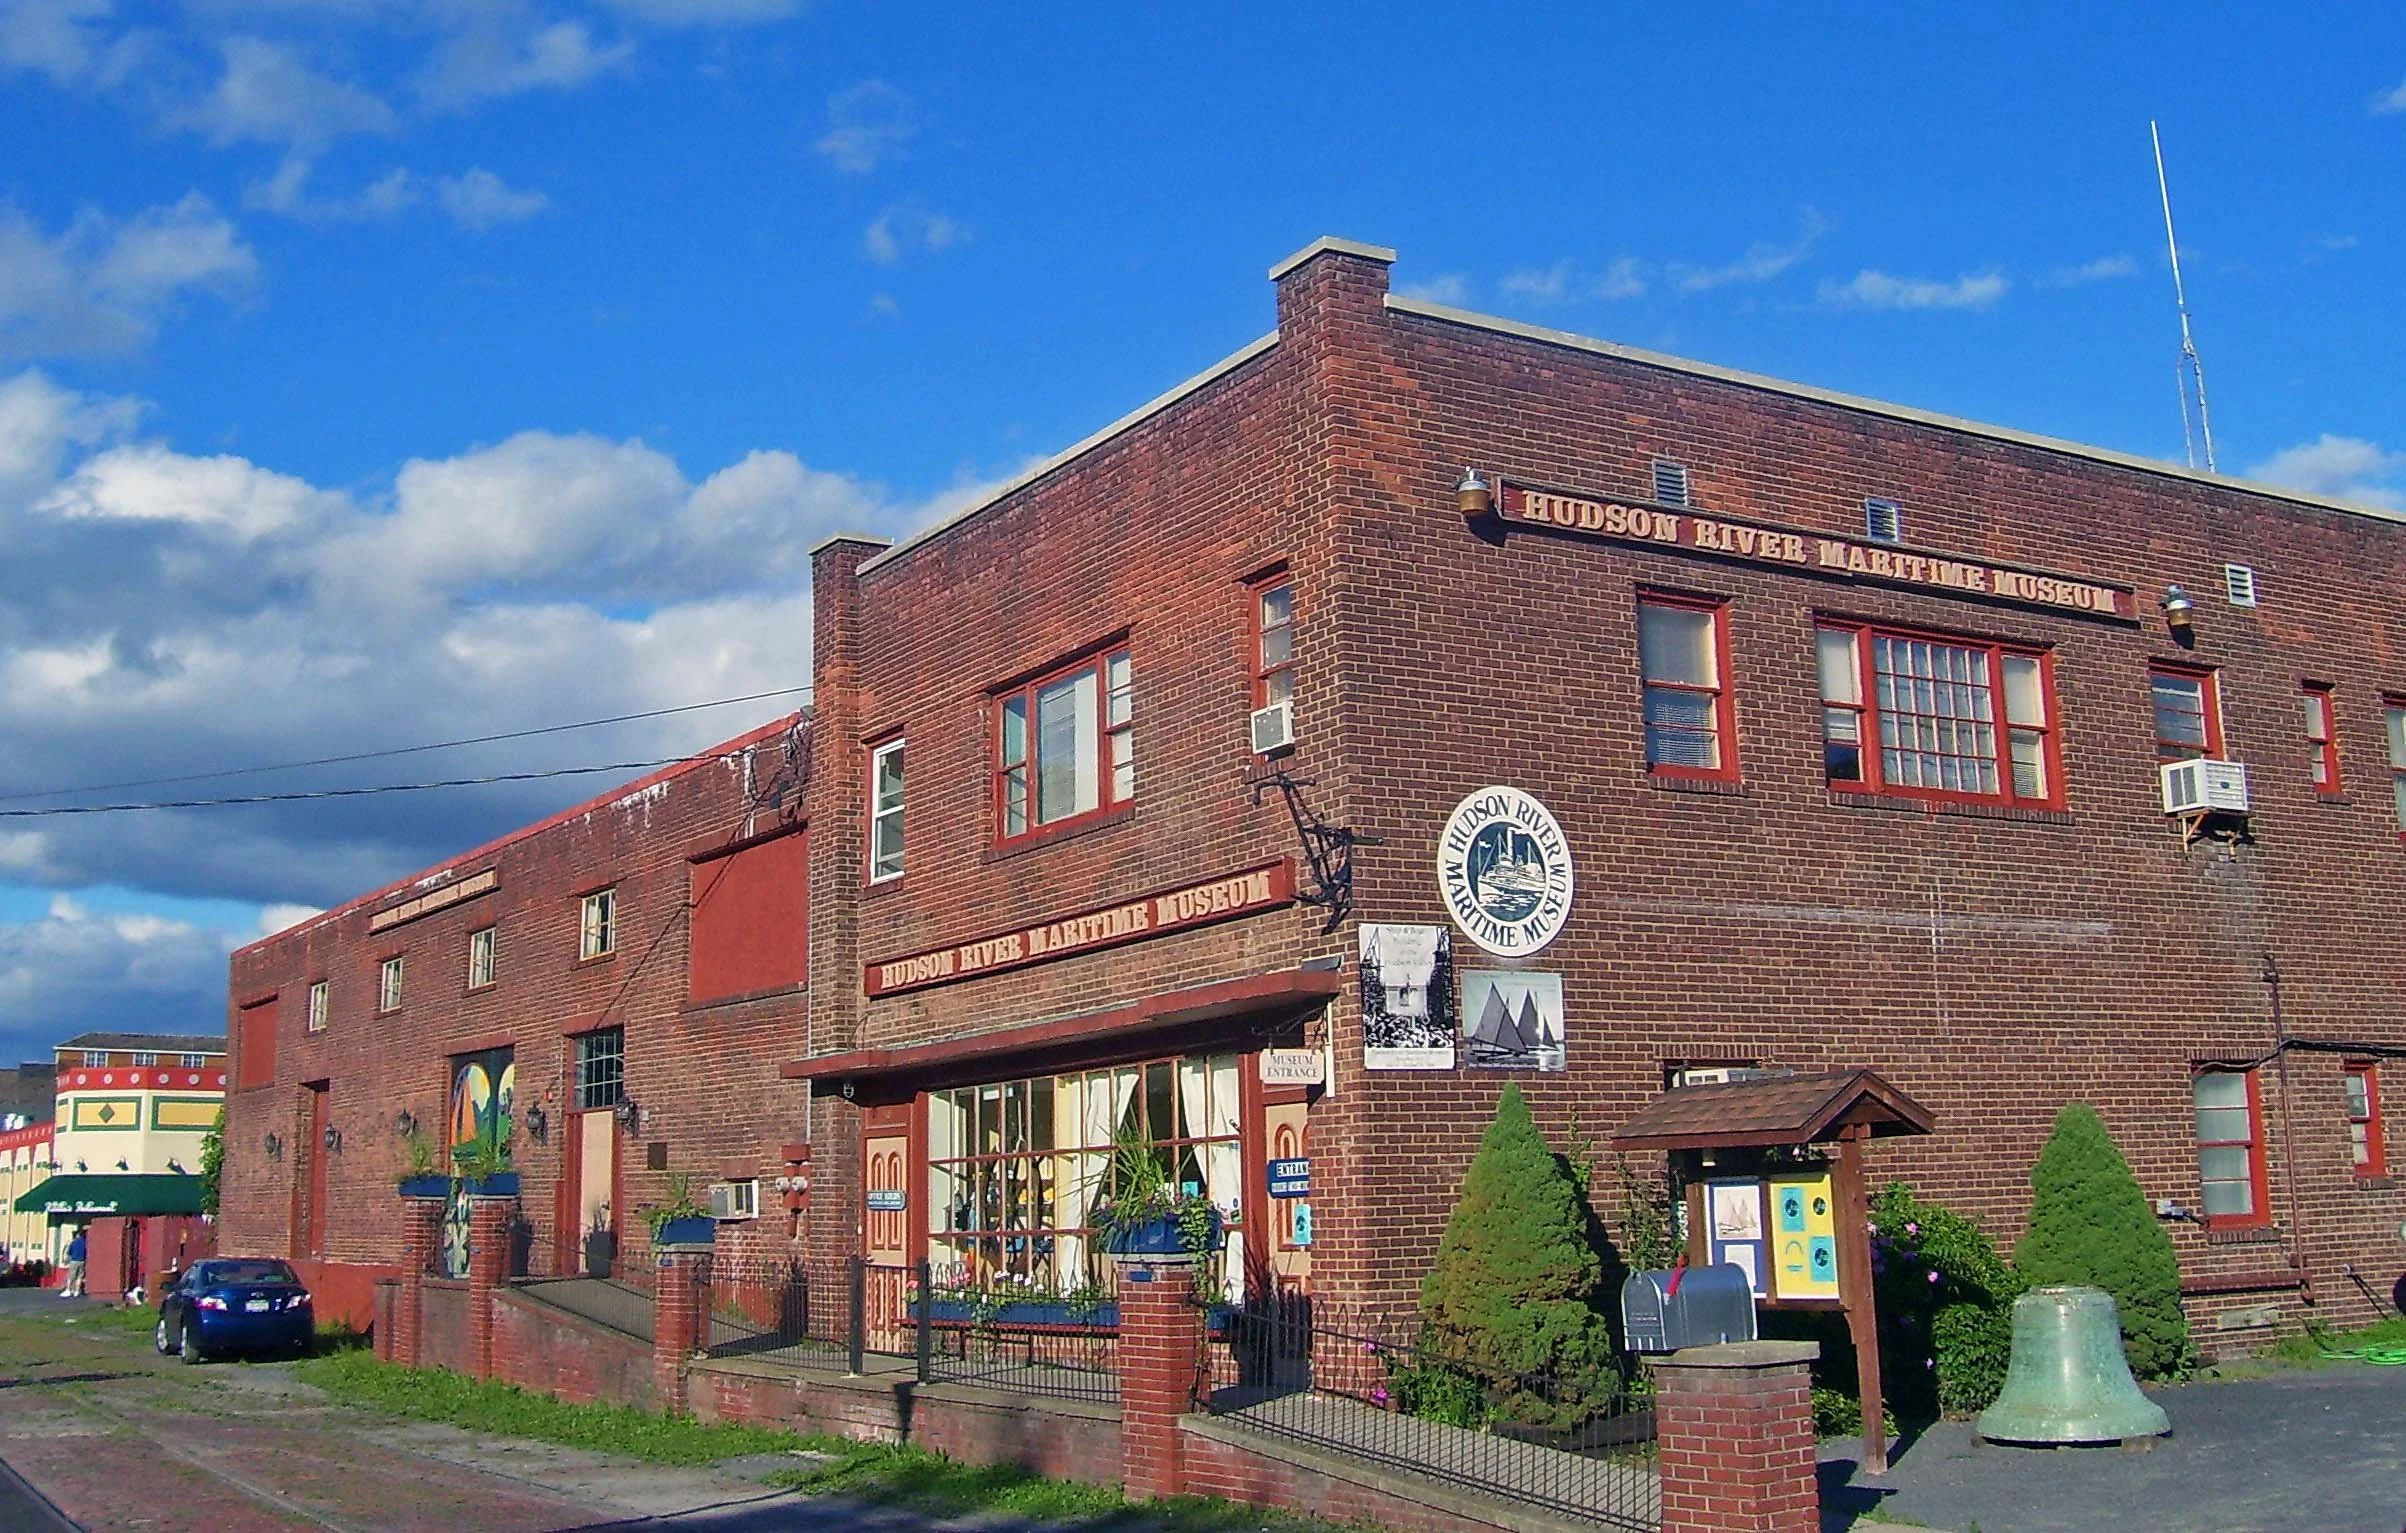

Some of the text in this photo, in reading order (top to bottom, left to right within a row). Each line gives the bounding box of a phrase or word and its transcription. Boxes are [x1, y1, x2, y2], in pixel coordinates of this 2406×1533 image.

[1522, 489, 2117, 613] HUDSON RIVER MARITIME MUSEUM
[1448, 794, 1562, 861] HUDSON RIVER
[880, 870, 1272, 989] HUDSON RIVER MARITIME MUSEUM
[1445, 859, 1567, 948] MARITIME MUSEUM
[1267, 1067, 1319, 1078] ENTRANCE
[1270, 1055, 1313, 1065] MUSEUM
[1276, 1162, 1309, 1177] ENTRAN
